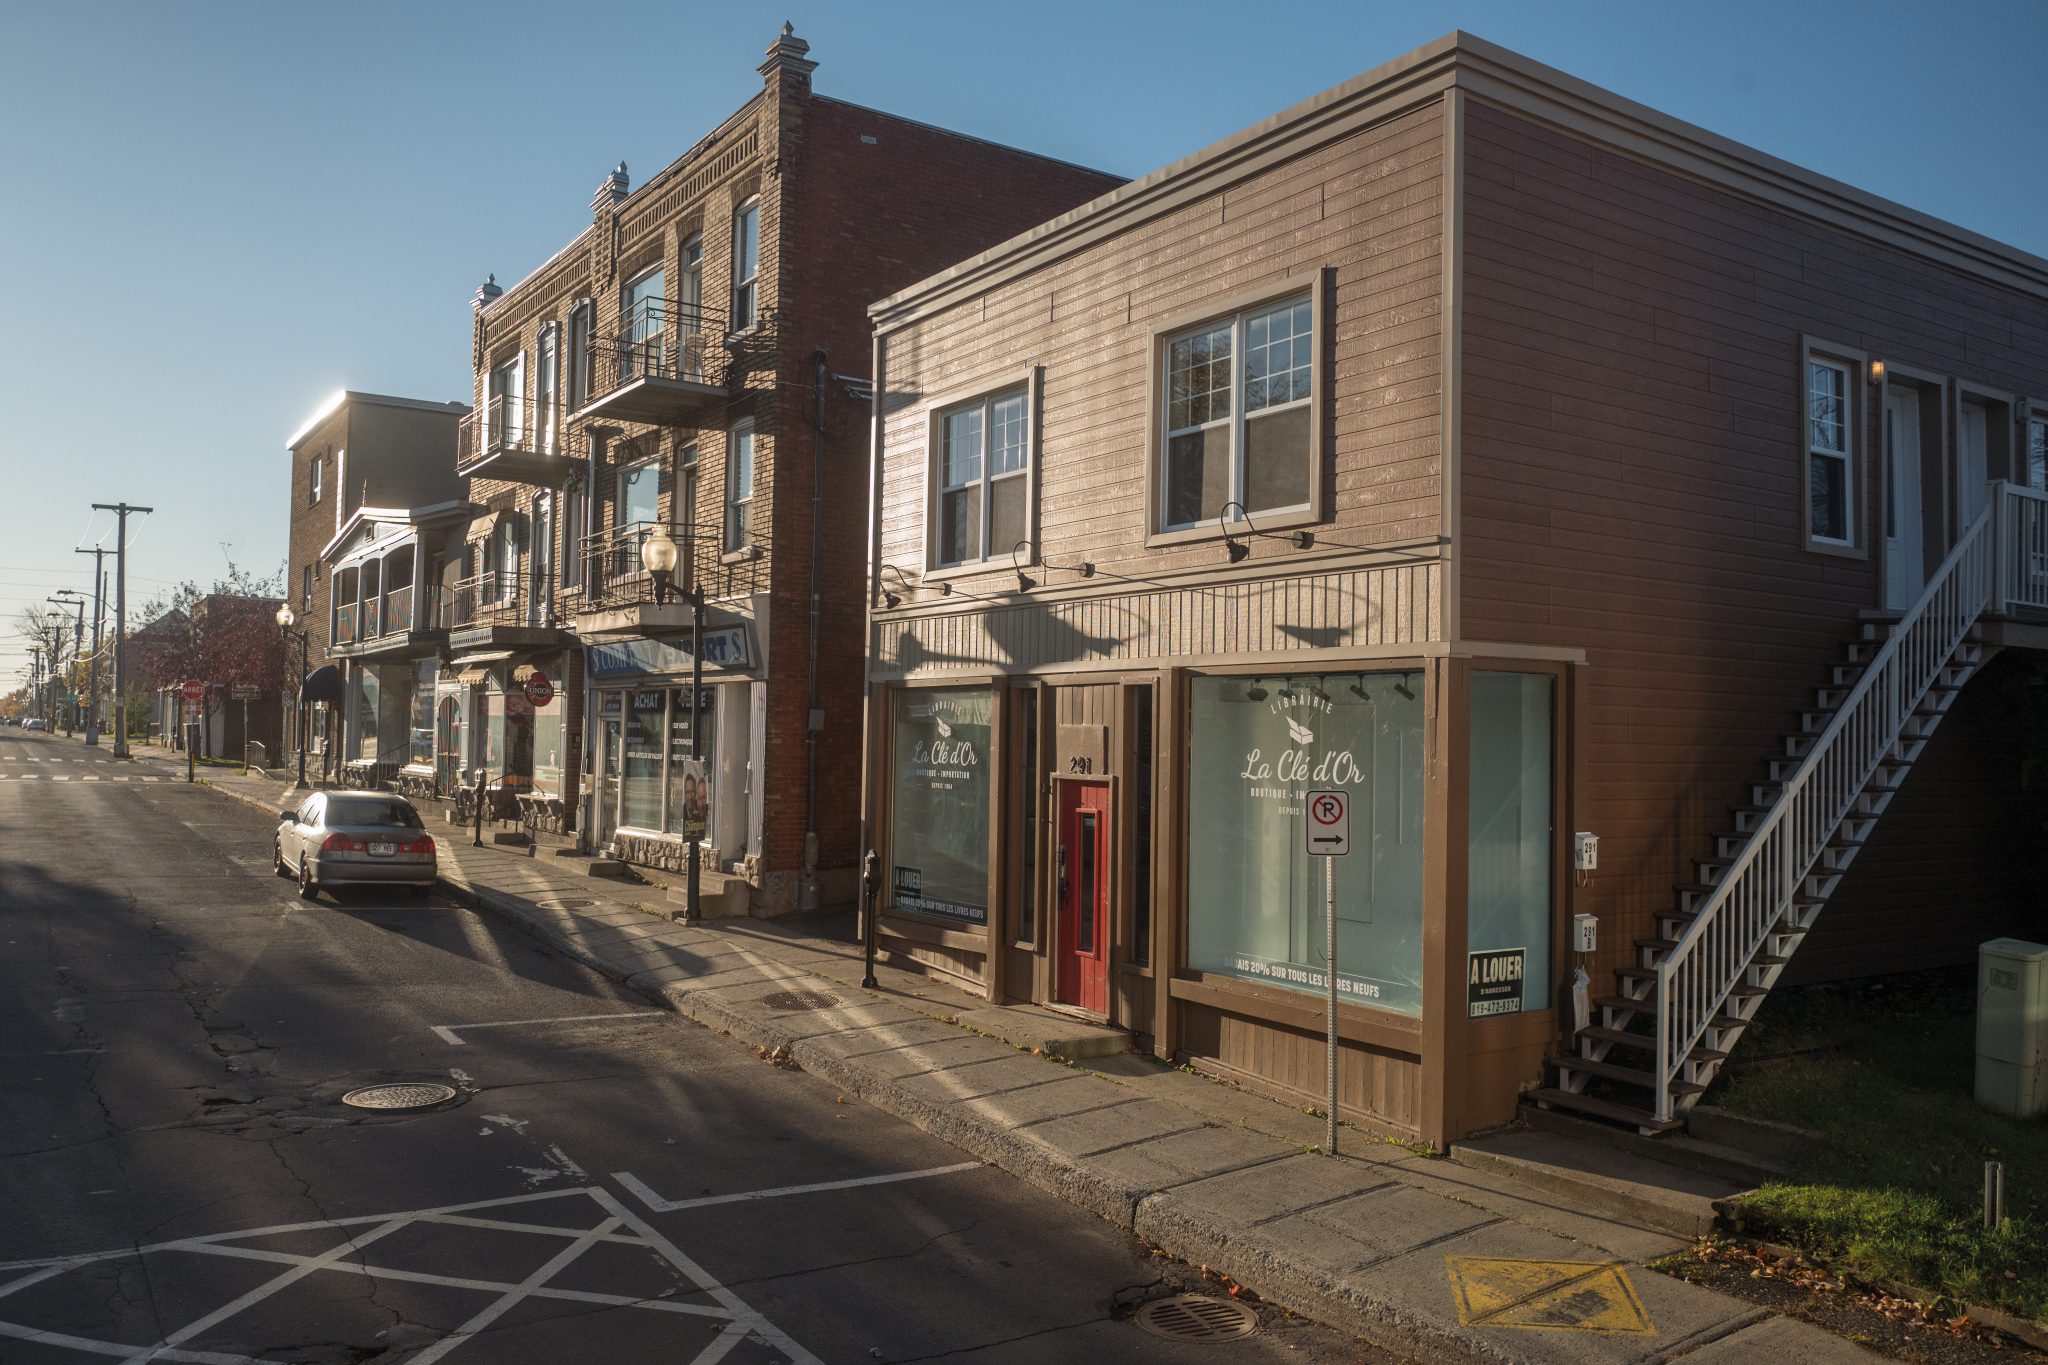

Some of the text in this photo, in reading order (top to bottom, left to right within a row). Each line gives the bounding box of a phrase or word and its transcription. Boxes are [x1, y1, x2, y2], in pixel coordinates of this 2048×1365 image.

[184, 686, 204, 694] ARRÊT
[529, 687, 552, 695] UNION
[634, 693, 659, 709] ACHAT
[928, 700, 962, 716] LIBRAIRIE
[1270, 694, 1333, 714] LIBRAIRIE
[912, 740, 978, 766] La Clé d'Or
[1070, 756, 1092, 774] 291
[1240, 748, 1365, 784] La Clé d'Or
[940, 770, 970, 779] IMPORTATION
[1250, 788, 1287, 800] BOUTIQUE
[1278, 806, 1300, 816] DEPUIS
[1585, 842, 1596, 854] 291
[1588, 854, 1592, 864] A
[896, 868, 920, 889] A LOUER
[926, 900, 934, 910] SUR
[935, 902, 946, 912] TOUS
[946, 904, 954, 914] LES
[954, 905, 969, 916] LIVRES
[970, 908, 984, 919] NEUFS
[1584, 926, 1595, 938] 291
[1587, 938, 1592, 948] B
[1470, 955, 1522, 984] A LOUER
[1250, 961, 1270, 976] 20%
[1272, 965, 1286, 979] SUR
[1288, 968, 1306, 984] TOUS
[1308, 972, 1322, 986] LES
[1324, 976, 1351, 992] LRES
[1352, 983, 1380, 998] NEUFS
